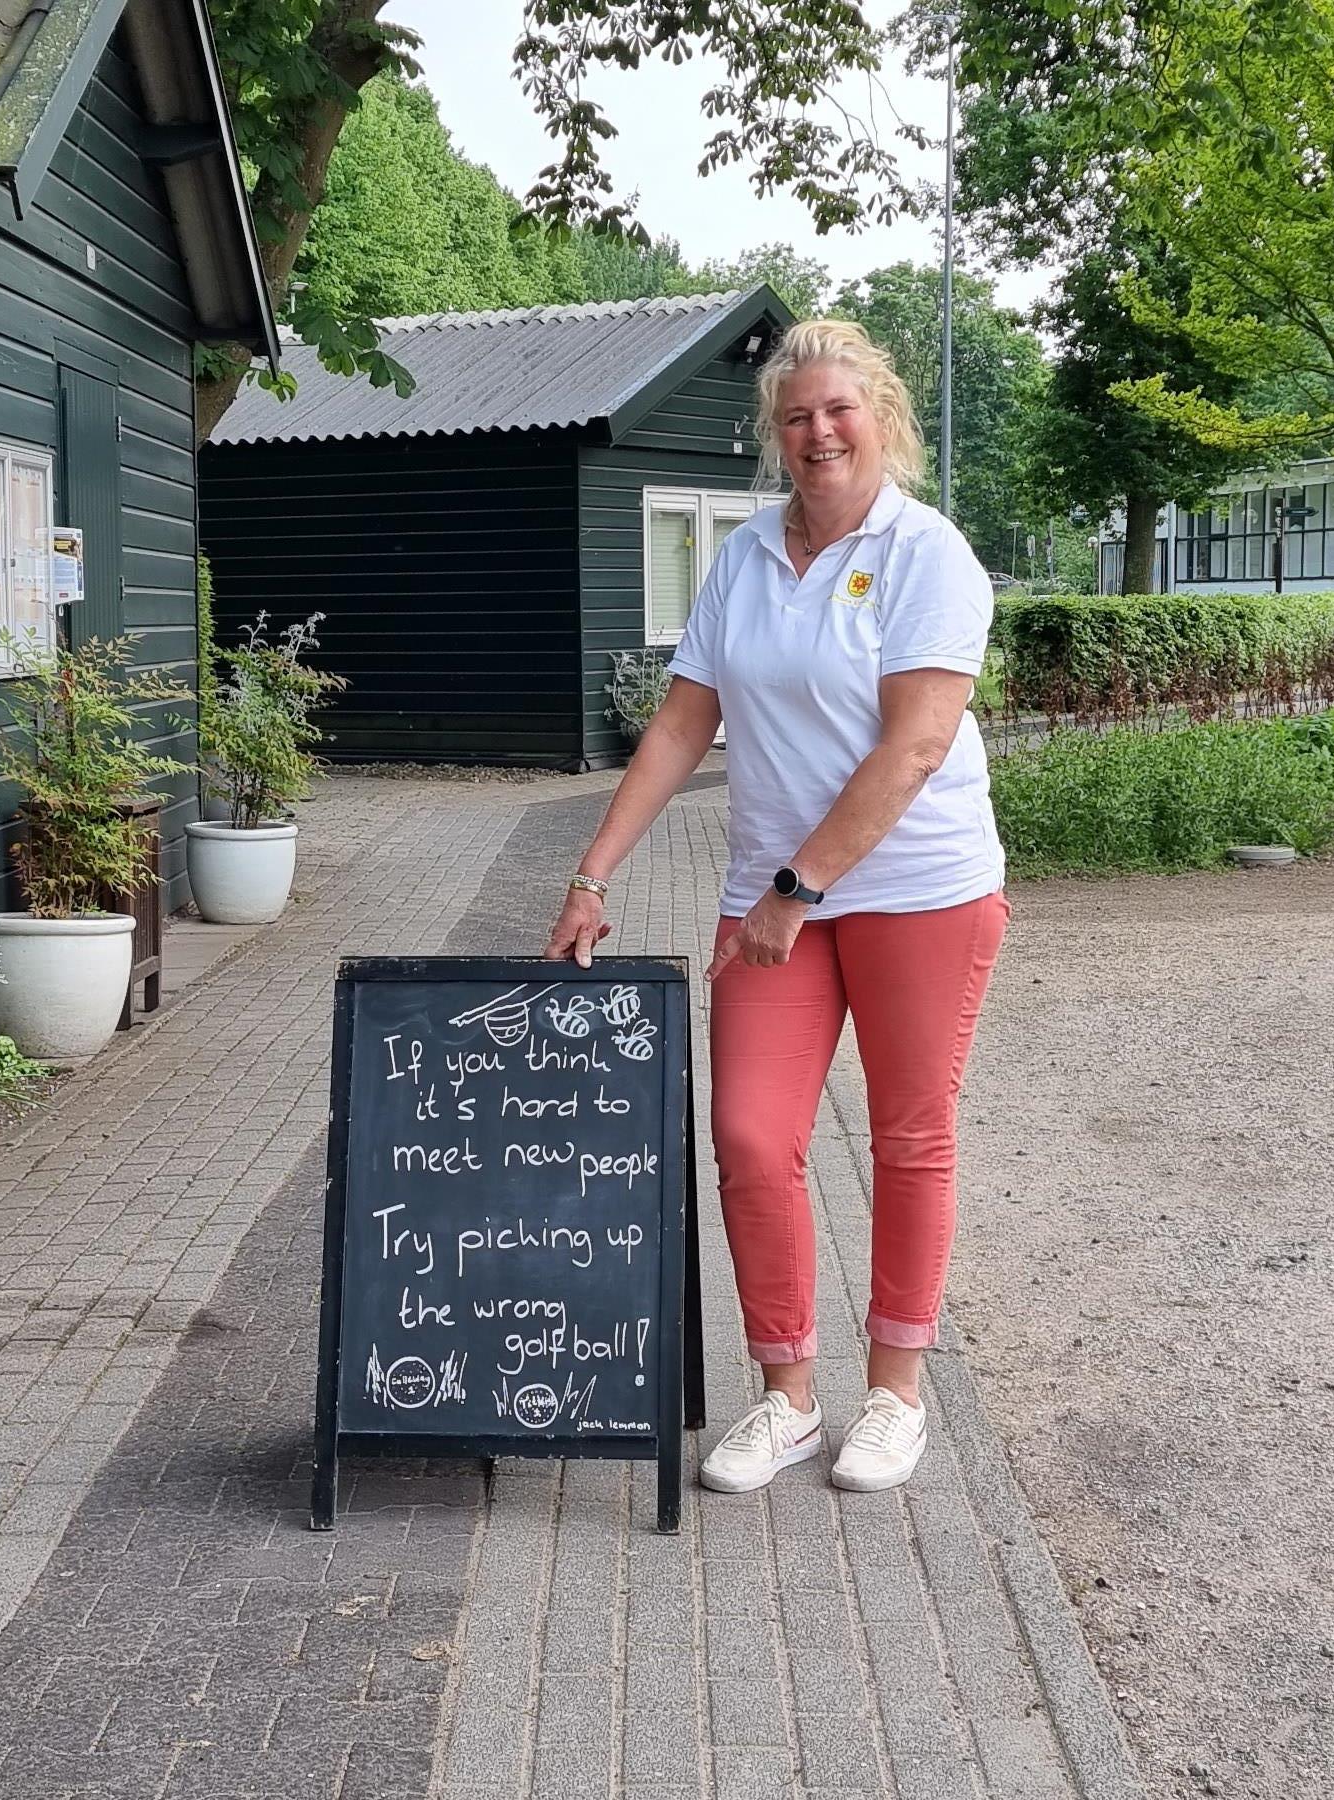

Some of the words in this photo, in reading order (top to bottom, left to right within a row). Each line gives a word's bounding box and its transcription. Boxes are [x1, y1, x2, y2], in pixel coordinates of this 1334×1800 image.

[383, 1034, 423, 1085] If
[446, 1051, 506, 1086] you
[524, 1034, 612, 1073] think
[416, 1083, 476, 1121] it's
[501, 1085, 578, 1118] hard
[593, 1084, 631, 1114] to
[393, 1137, 483, 1174] meet
[504, 1141, 575, 1168] new
[579, 1143, 658, 1198] people
[372, 1203, 434, 1275] Try
[457, 1216, 593, 1278] picking
[606, 1223, 643, 1265] up
[399, 1286, 456, 1330] the
[473, 1298, 567, 1333] wrong
[576, 1416, 604, 1432] jack
